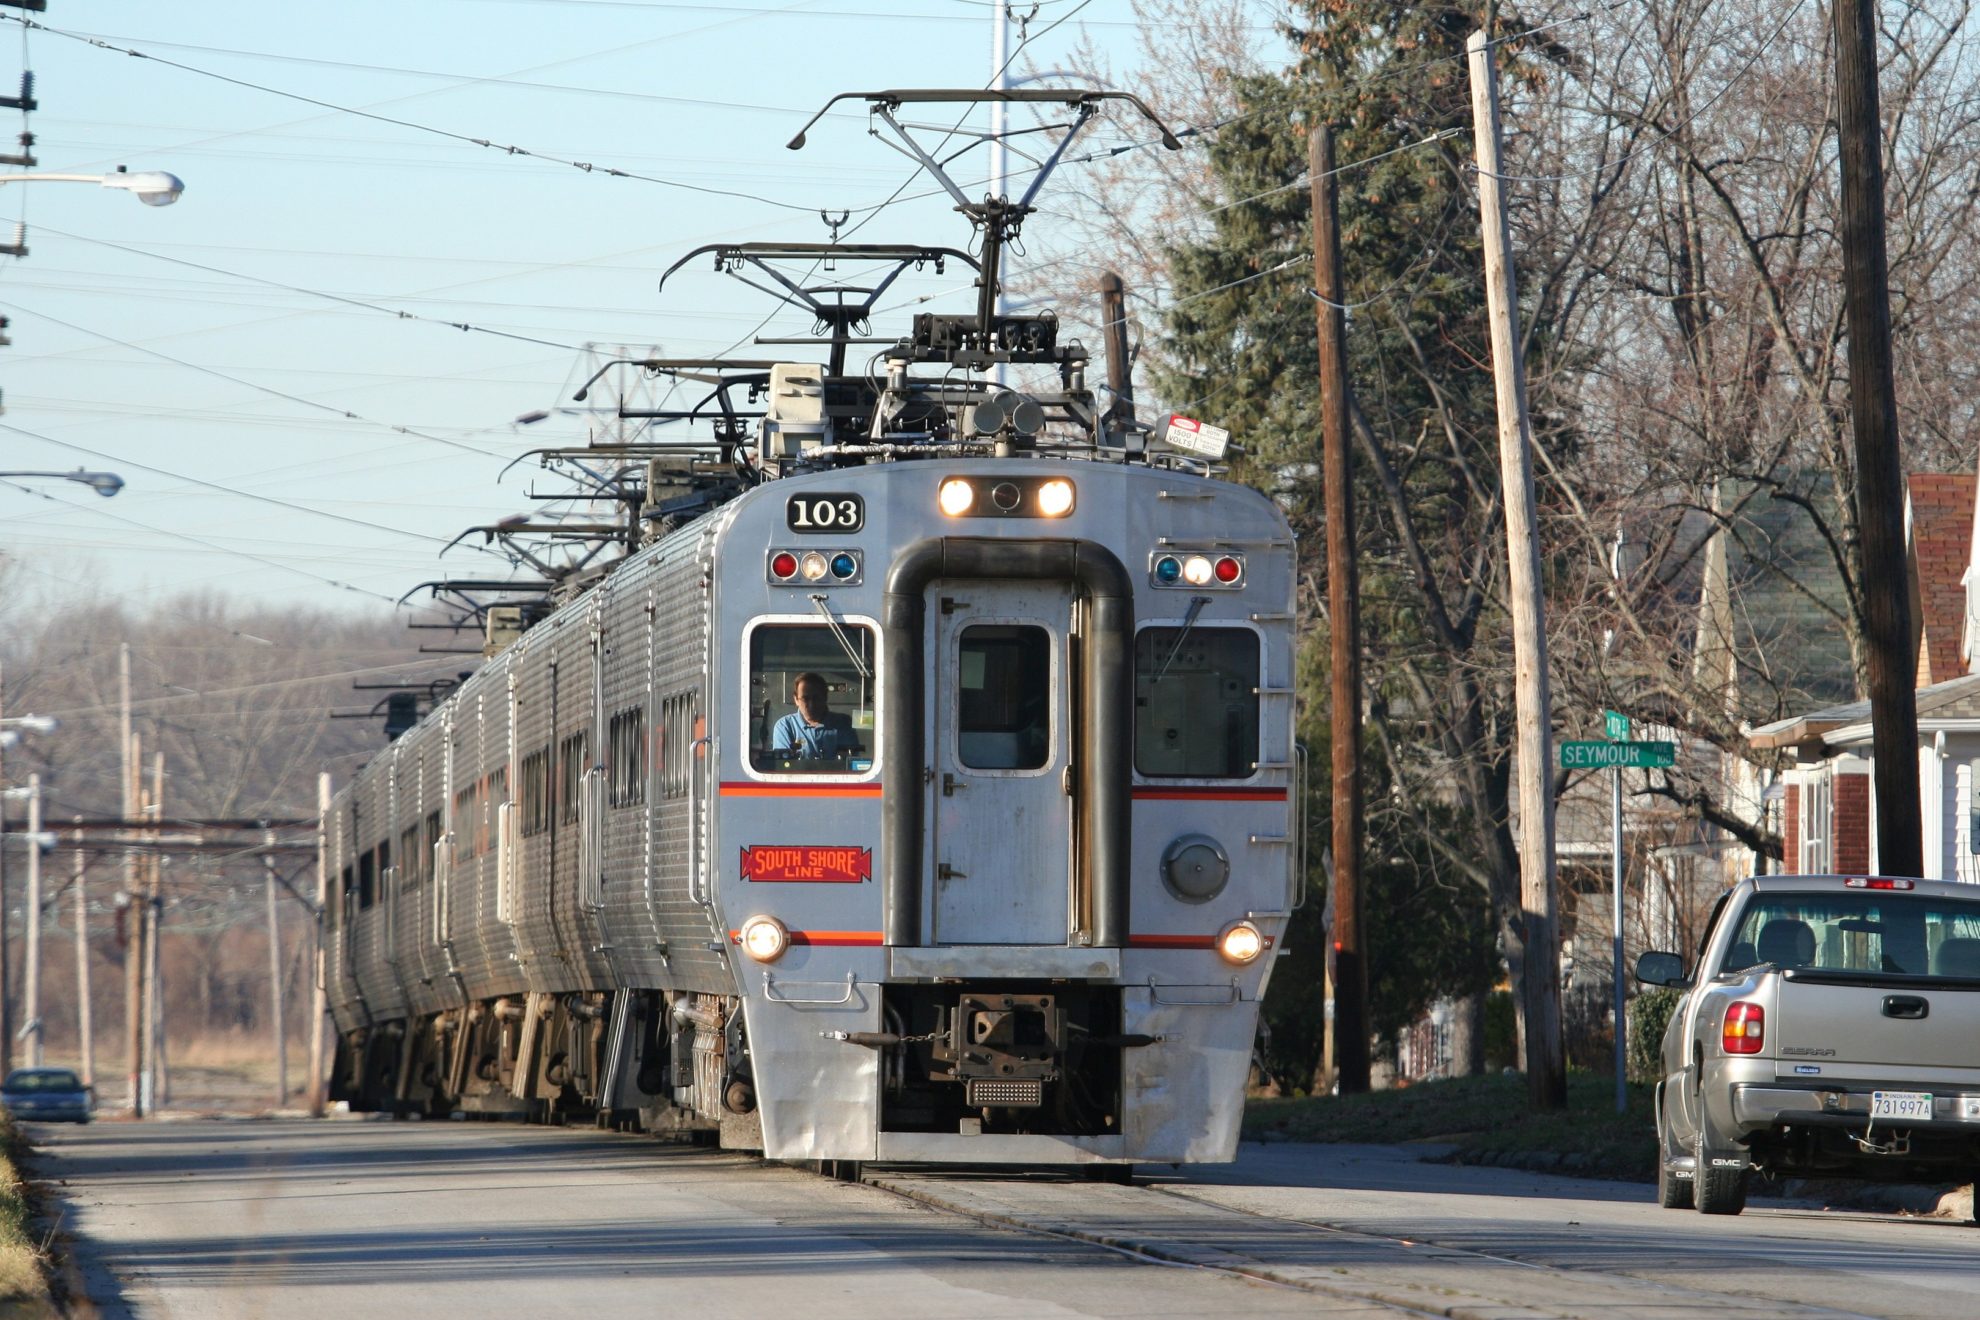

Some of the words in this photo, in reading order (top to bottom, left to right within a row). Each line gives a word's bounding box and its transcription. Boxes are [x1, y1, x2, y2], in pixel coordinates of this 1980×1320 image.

[1174, 429, 1192, 439] 1500
[1169, 435, 1192, 447] VOLTS
[793, 500, 857, 526] 103
[1565, 745, 1640, 764] SEYMOUR
[1652, 745, 1669, 753] AVE
[1657, 755, 1671, 764] 100
[755, 850, 801, 874] SOUTH
[809, 851, 857, 877] SHORE
[784, 867, 824, 878] LINE
[1782, 1047, 1836, 1056] SIERRA
[1875, 1100, 1930, 1115] 731997A
[1712, 1158, 1741, 1167] GMC
